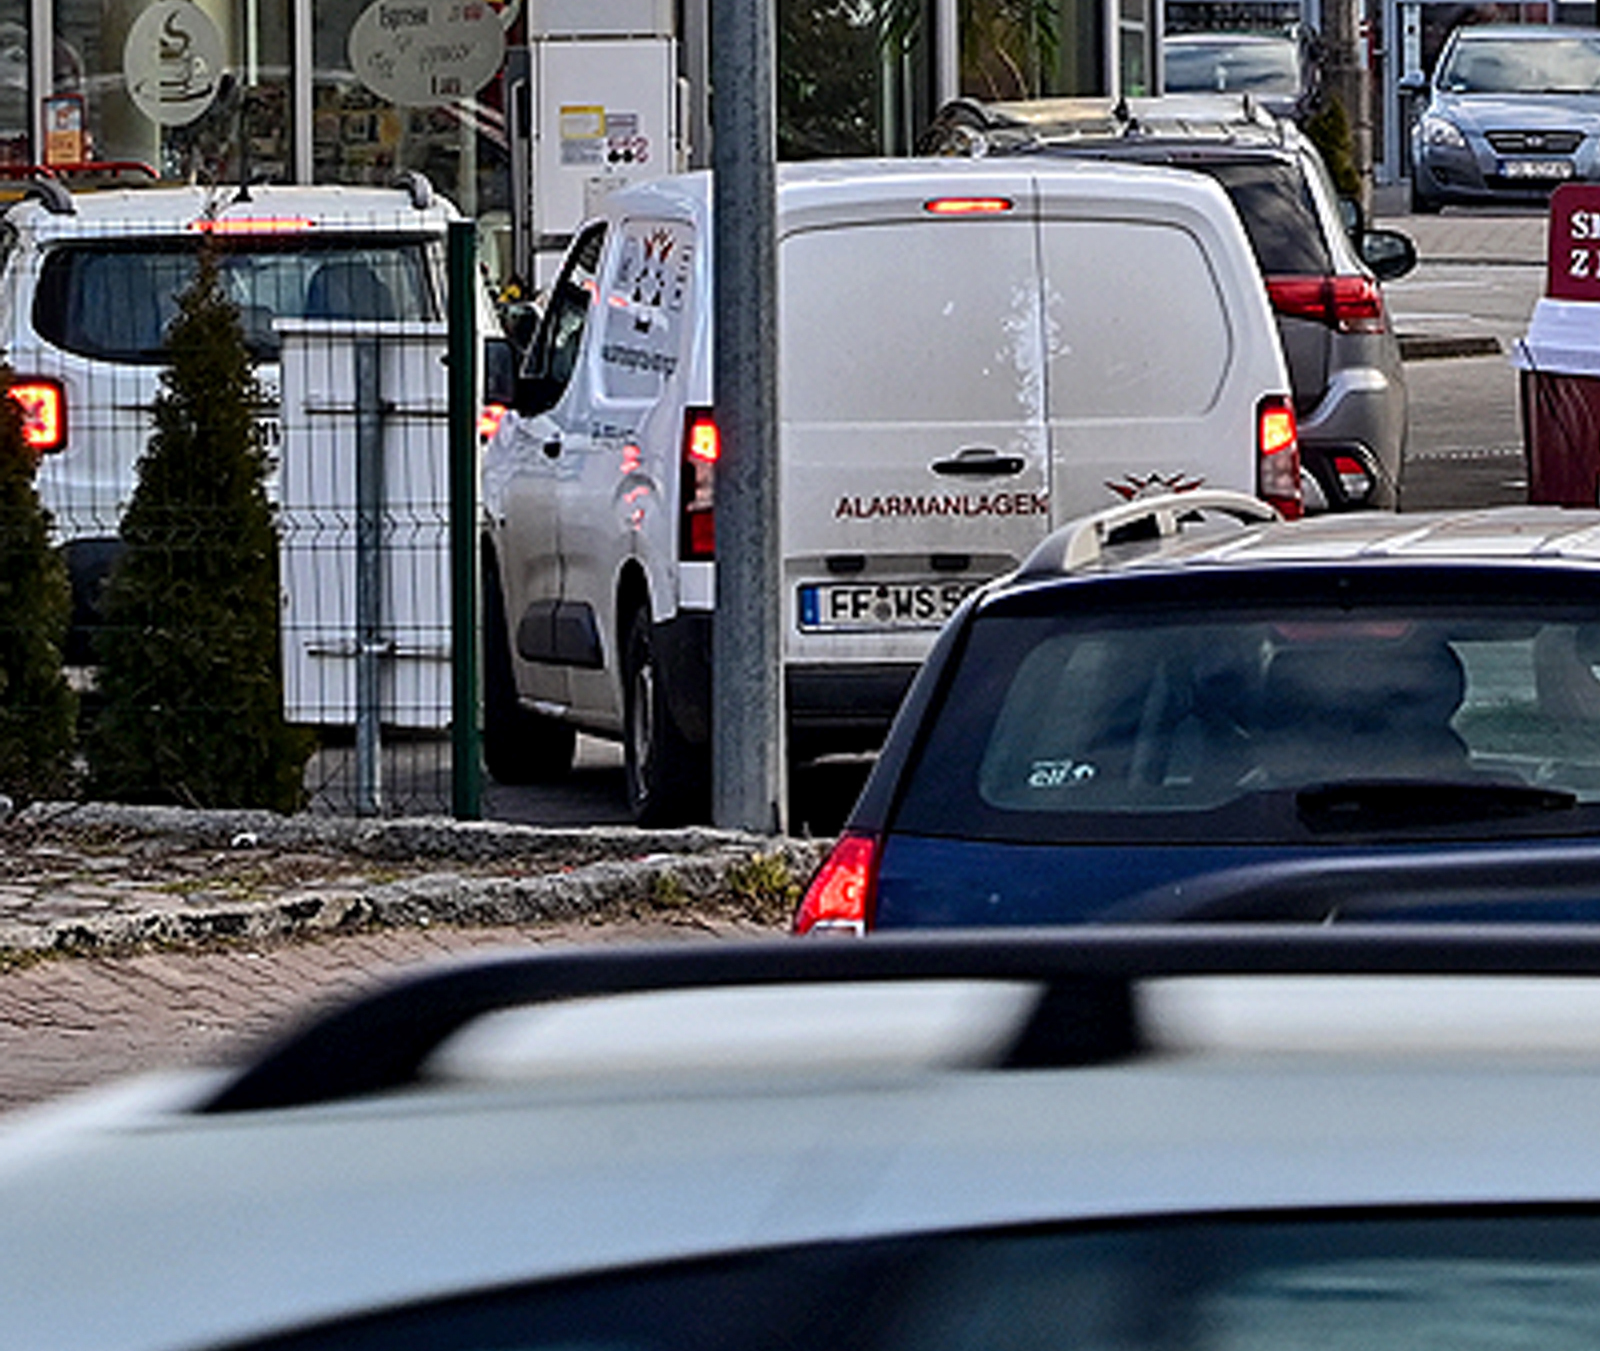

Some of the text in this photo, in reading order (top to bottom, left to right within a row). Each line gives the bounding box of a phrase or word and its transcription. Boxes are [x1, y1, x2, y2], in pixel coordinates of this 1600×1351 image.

[1570, 250, 1589, 277] Z
[835, 492, 1050, 518] ALARMANLAGEN
[830, 588, 872, 619] FF
[895, 587, 936, 619] WS
